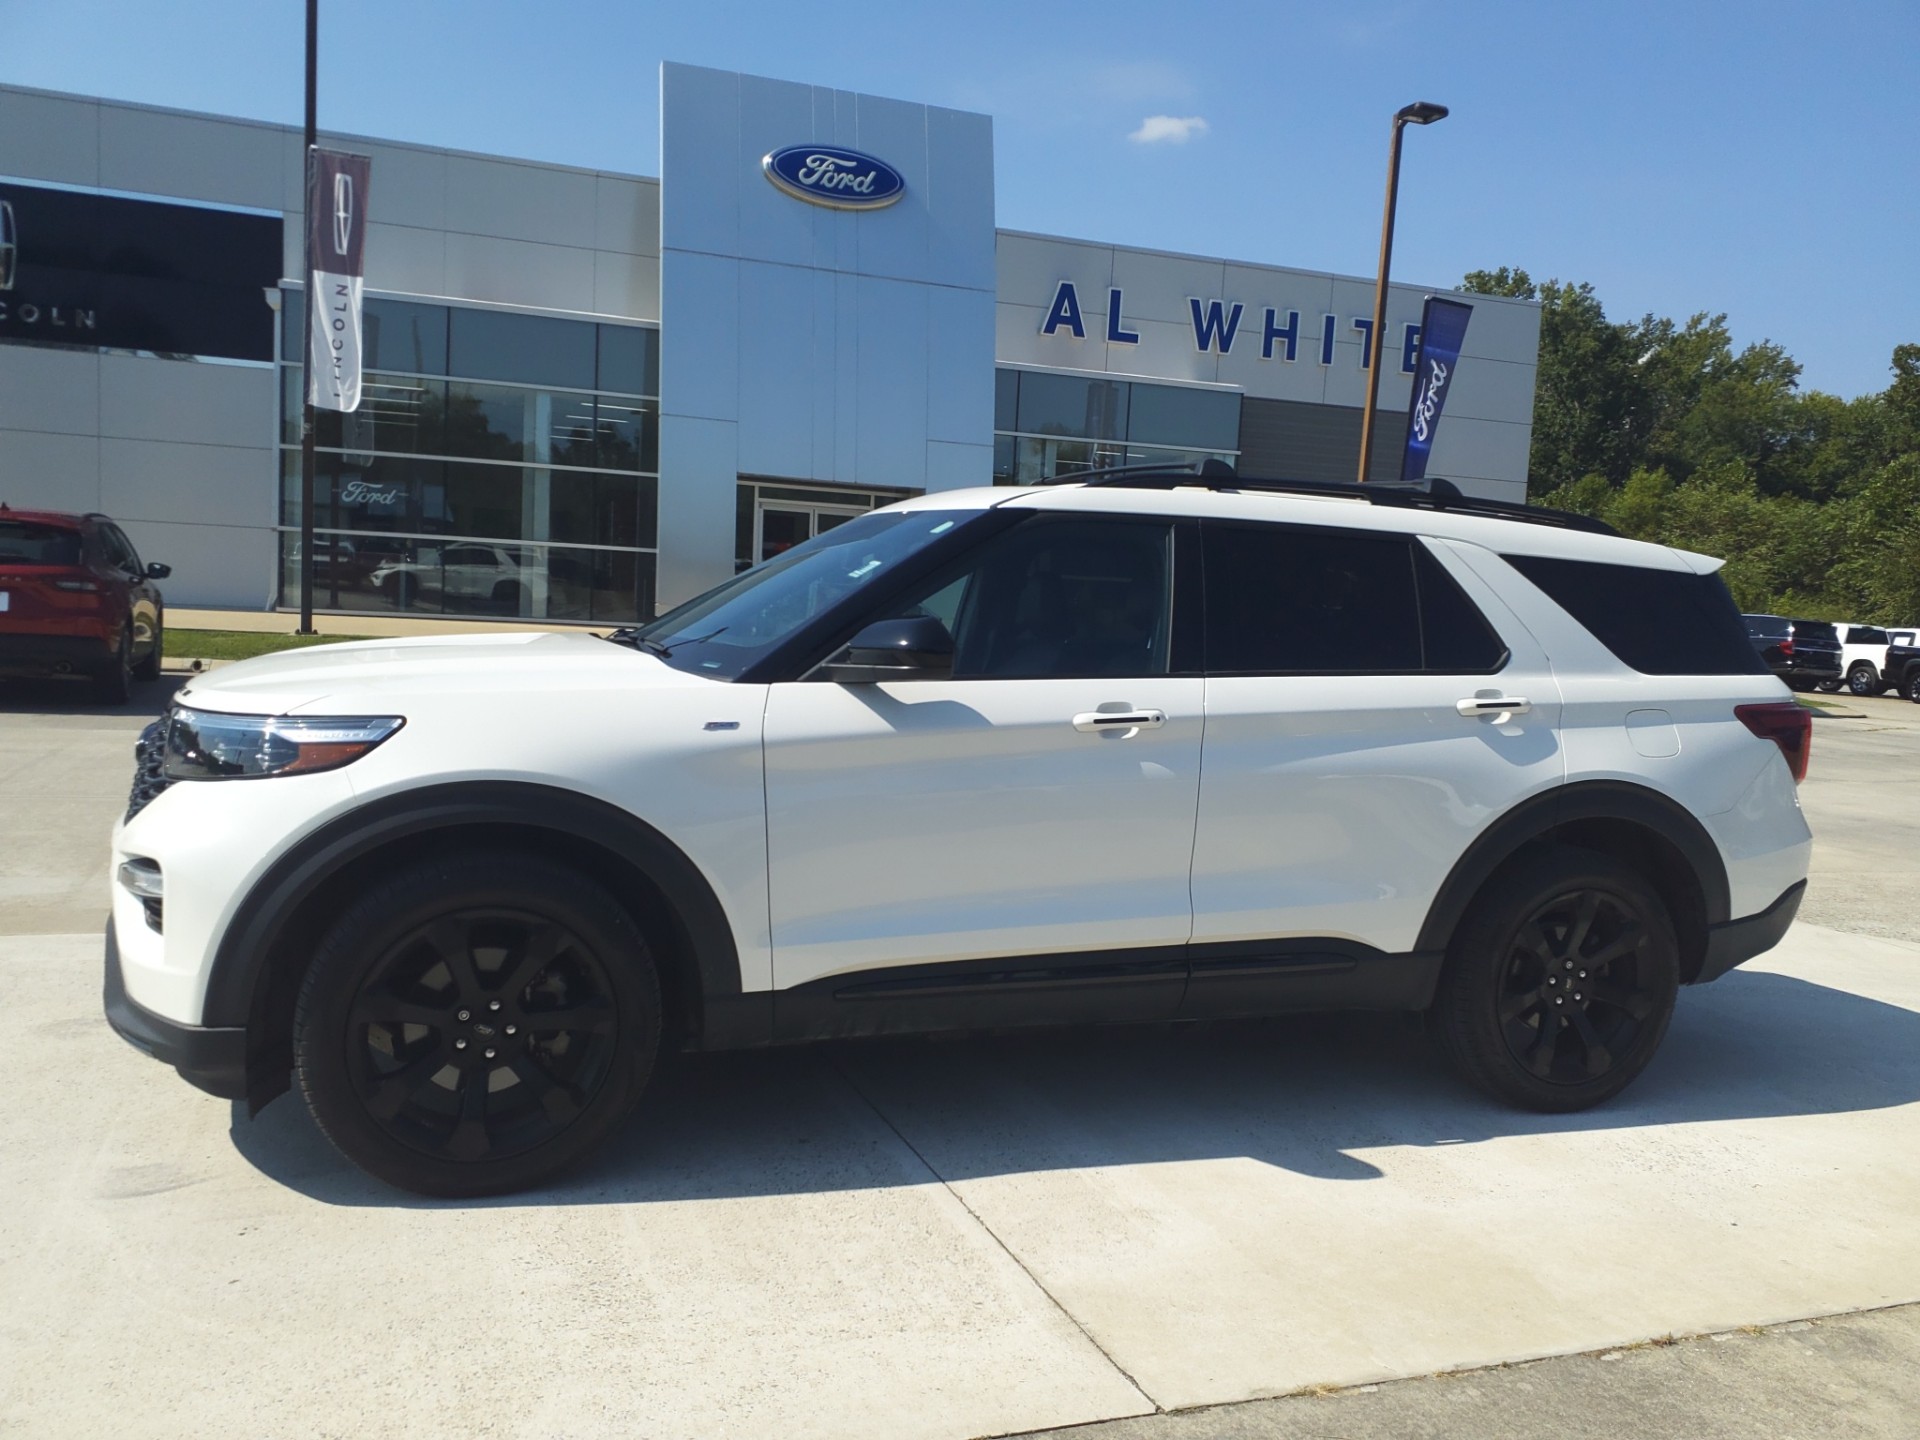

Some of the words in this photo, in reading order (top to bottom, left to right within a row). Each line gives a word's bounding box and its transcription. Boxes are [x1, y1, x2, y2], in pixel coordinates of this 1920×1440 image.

[798, 154, 877, 193] Ford
[1040, 280, 1140, 345] AL
[1413, 358, 1448, 442] Ford
[341, 481, 397, 505] Ford
